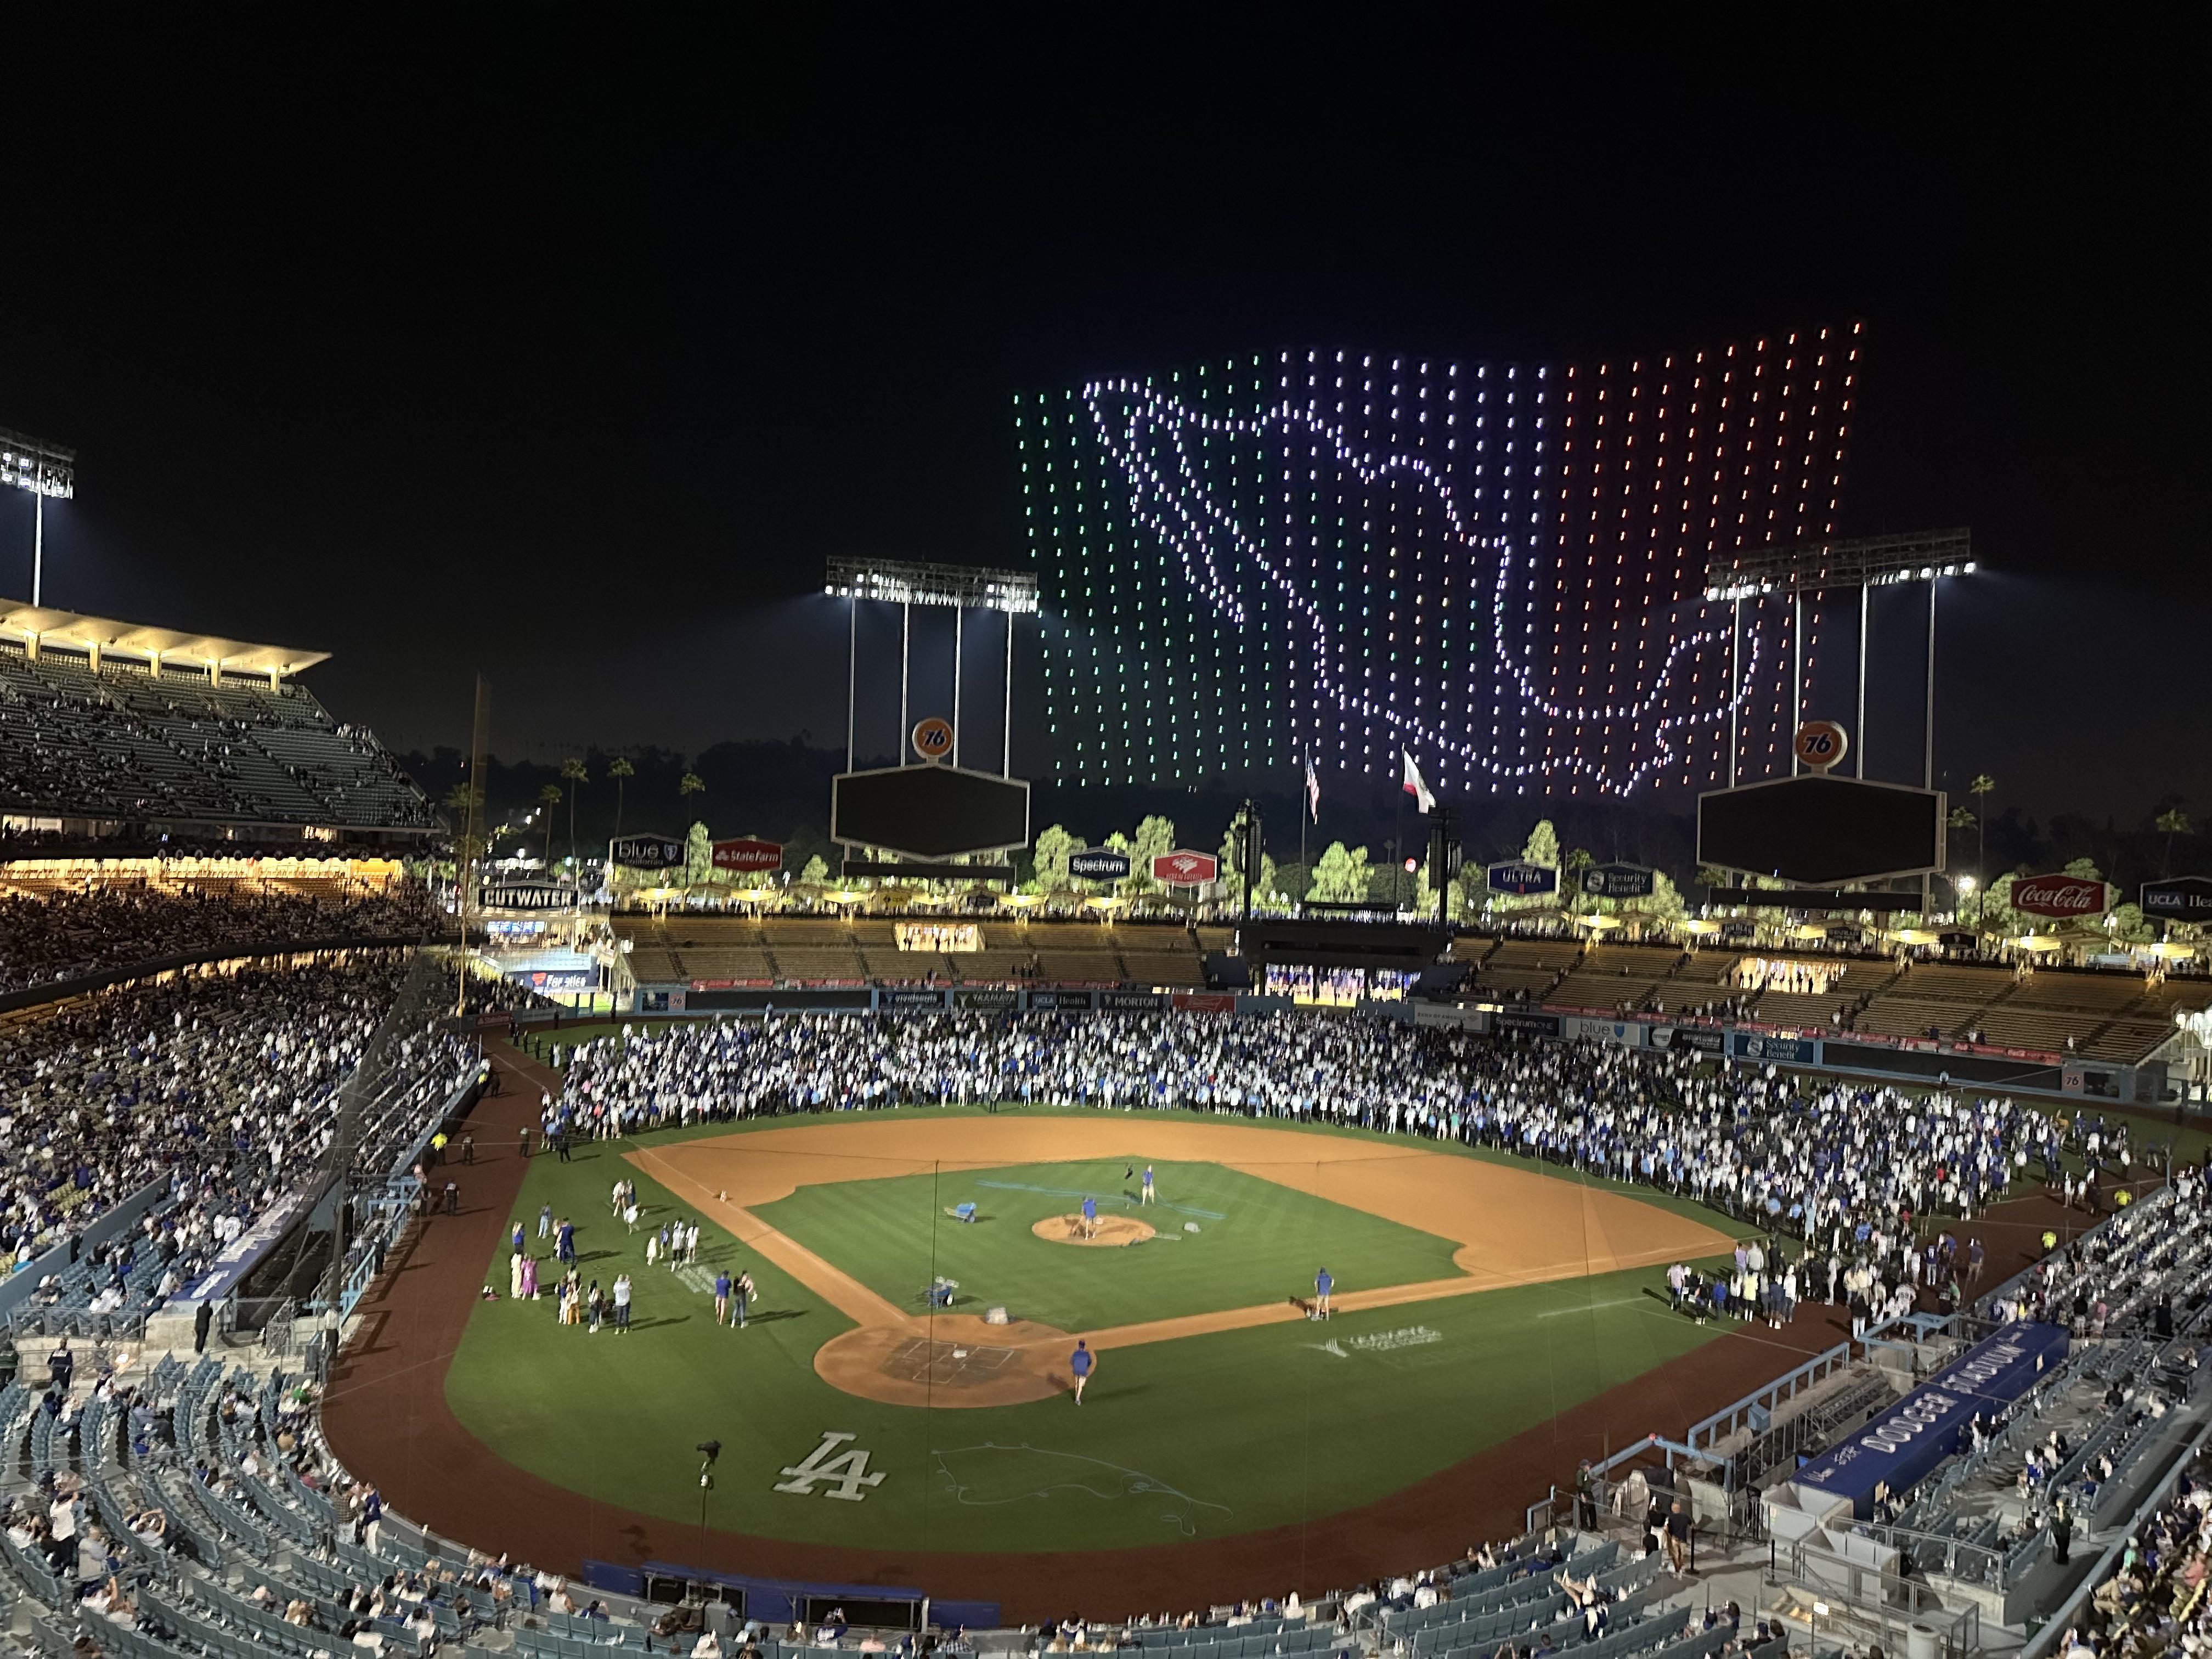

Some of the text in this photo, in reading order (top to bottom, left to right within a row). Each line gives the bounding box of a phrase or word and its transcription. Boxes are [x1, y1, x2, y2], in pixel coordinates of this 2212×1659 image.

[922, 727, 946, 747] 76
[1802, 732, 1833, 755] 76
[618, 840, 659, 860] blue
[1073, 857, 1124, 873] Spectrum
[1503, 869, 1542, 884] ULTRA
[1608, 872, 1646, 885] Security
[1608, 882, 1641, 894] Benefit
[484, 888, 572, 906] CUTWATER
[2018, 884, 2097, 909] Coca-Cola
[2148, 895, 2181, 905] UCLA
[1059, 996, 1086, 1006] Health
[1115, 996, 1158, 1008] MORTON
[1580, 1020, 1610, 1035] blue
[1765, 1039, 1801, 1053] Security
[1766, 1047, 1796, 1060] Benefit
[2065, 1076, 2080, 1086] 76
[772, 1431, 887, 1502] LA
